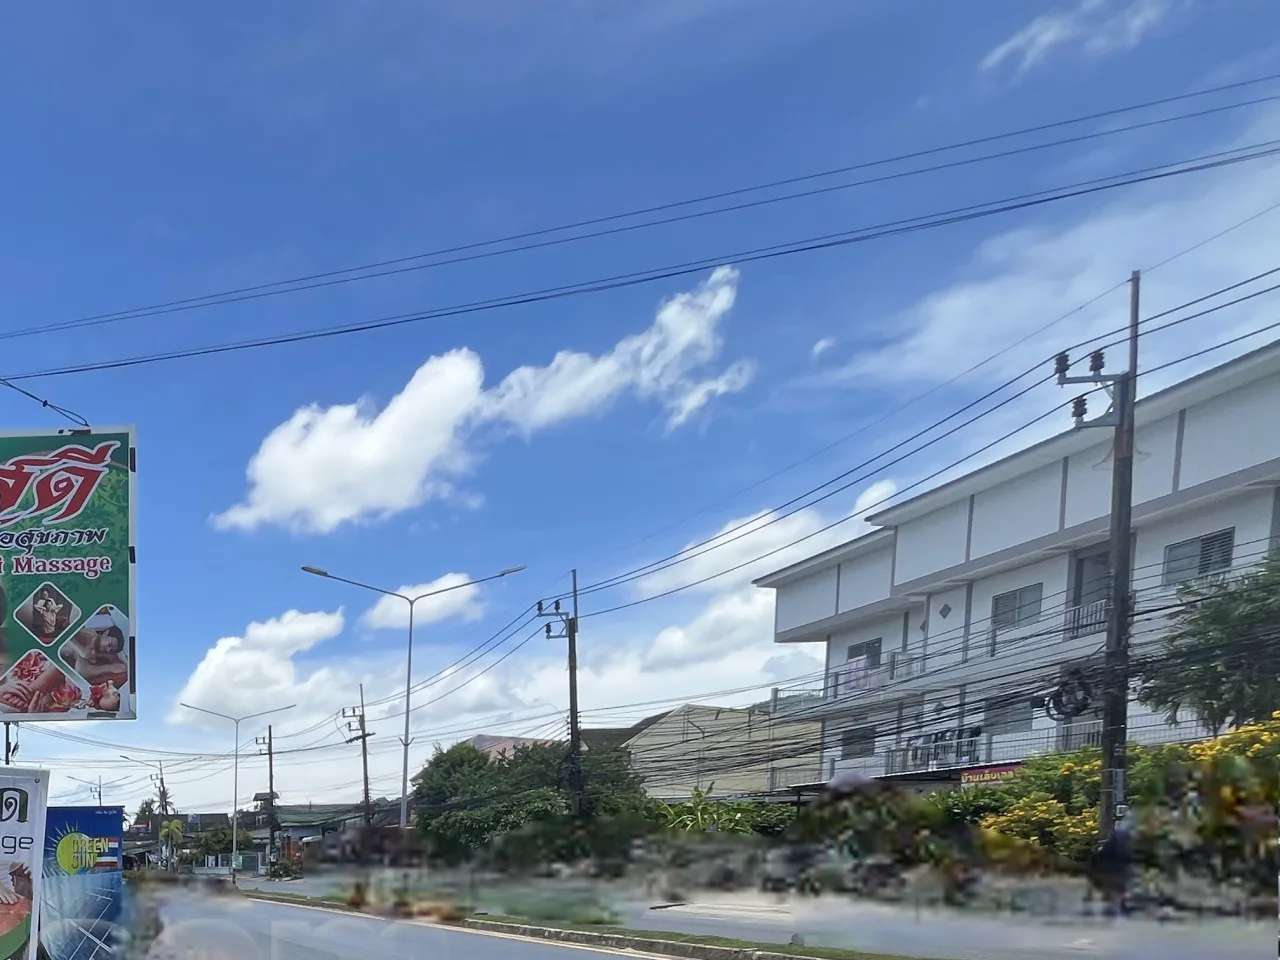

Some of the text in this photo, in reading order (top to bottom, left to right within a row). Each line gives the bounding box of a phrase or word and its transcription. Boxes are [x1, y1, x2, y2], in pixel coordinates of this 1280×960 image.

[13, 556, 112, 578] Massage
[71, 838, 109, 853] GREEN
[71, 853, 95, 868] SUN
